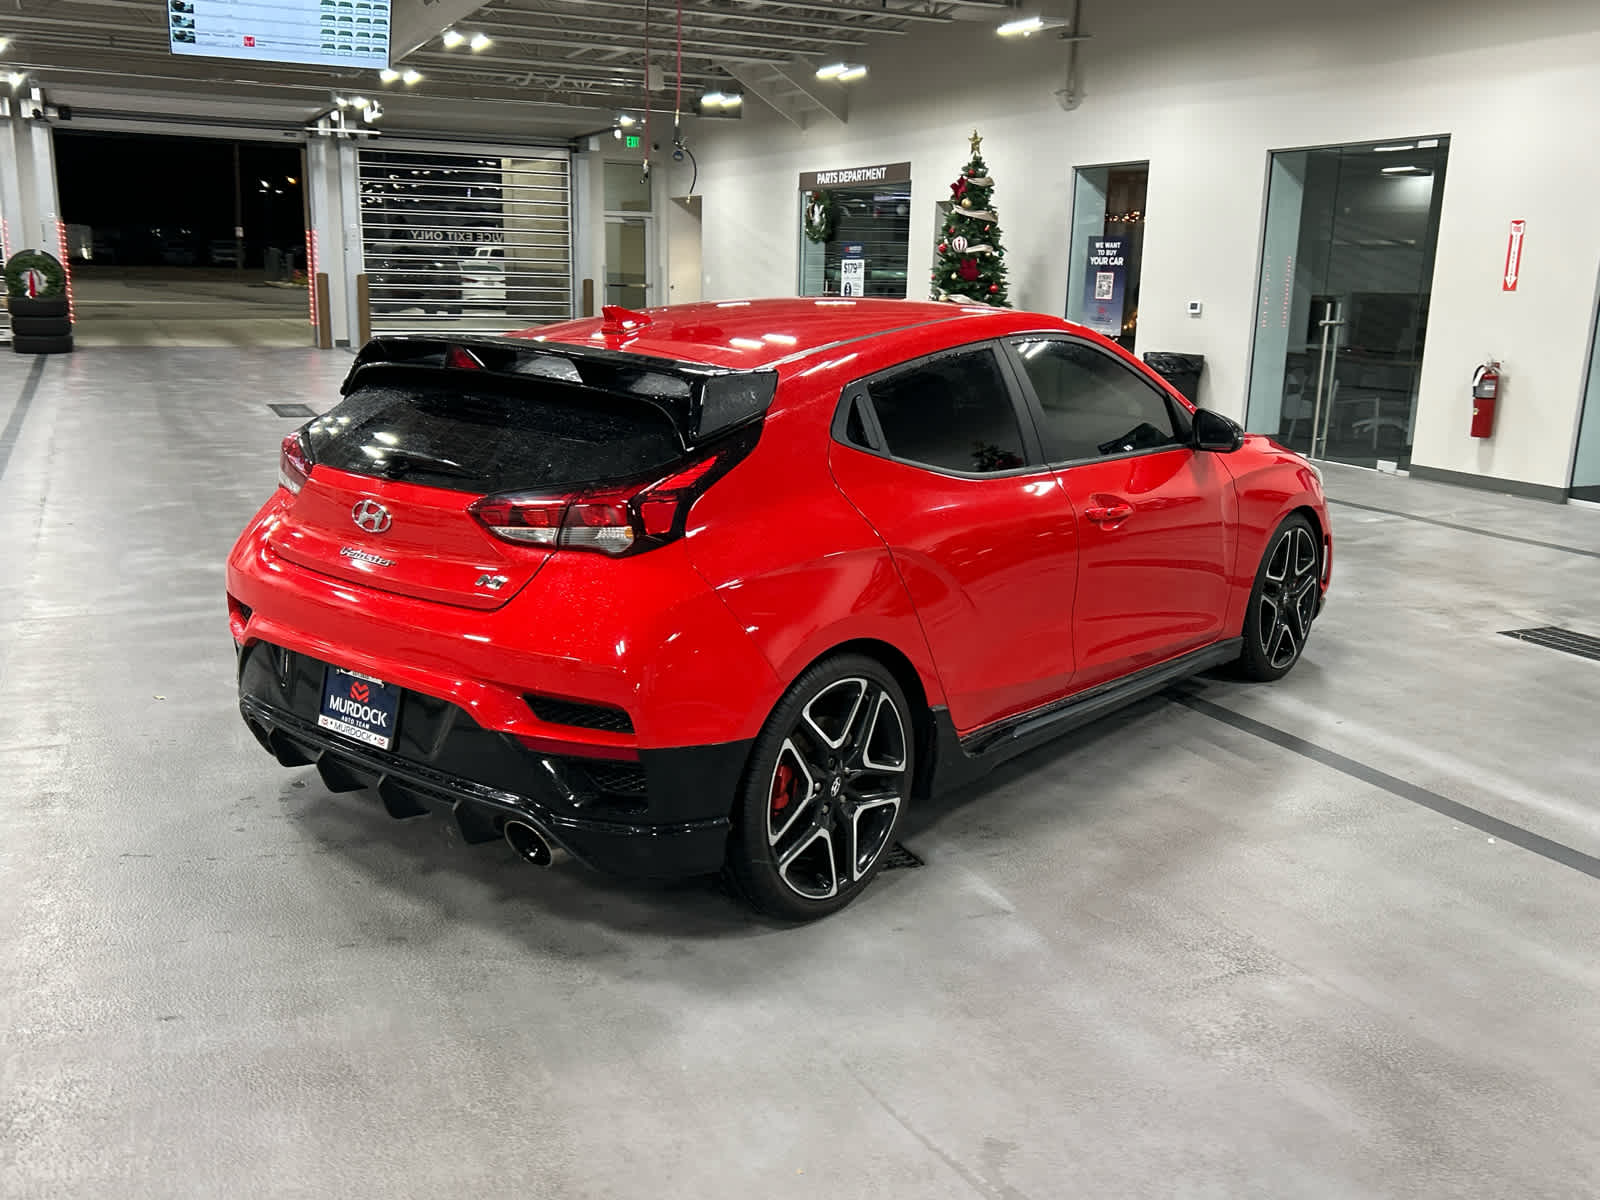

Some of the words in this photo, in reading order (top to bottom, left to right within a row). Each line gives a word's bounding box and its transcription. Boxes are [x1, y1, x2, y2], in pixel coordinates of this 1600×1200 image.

[816, 172, 838, 185] PARTS
[839, 166, 887, 183] DEPARTMENT
[1090, 256, 1108, 265] YOUR
[1109, 257, 1124, 266] CAR
[329, 695, 388, 728] MURDOCK
[334, 721, 373, 741] MURDOCK
[341, 715, 355, 725] AUTO
[356, 720, 370, 730] TEAM
